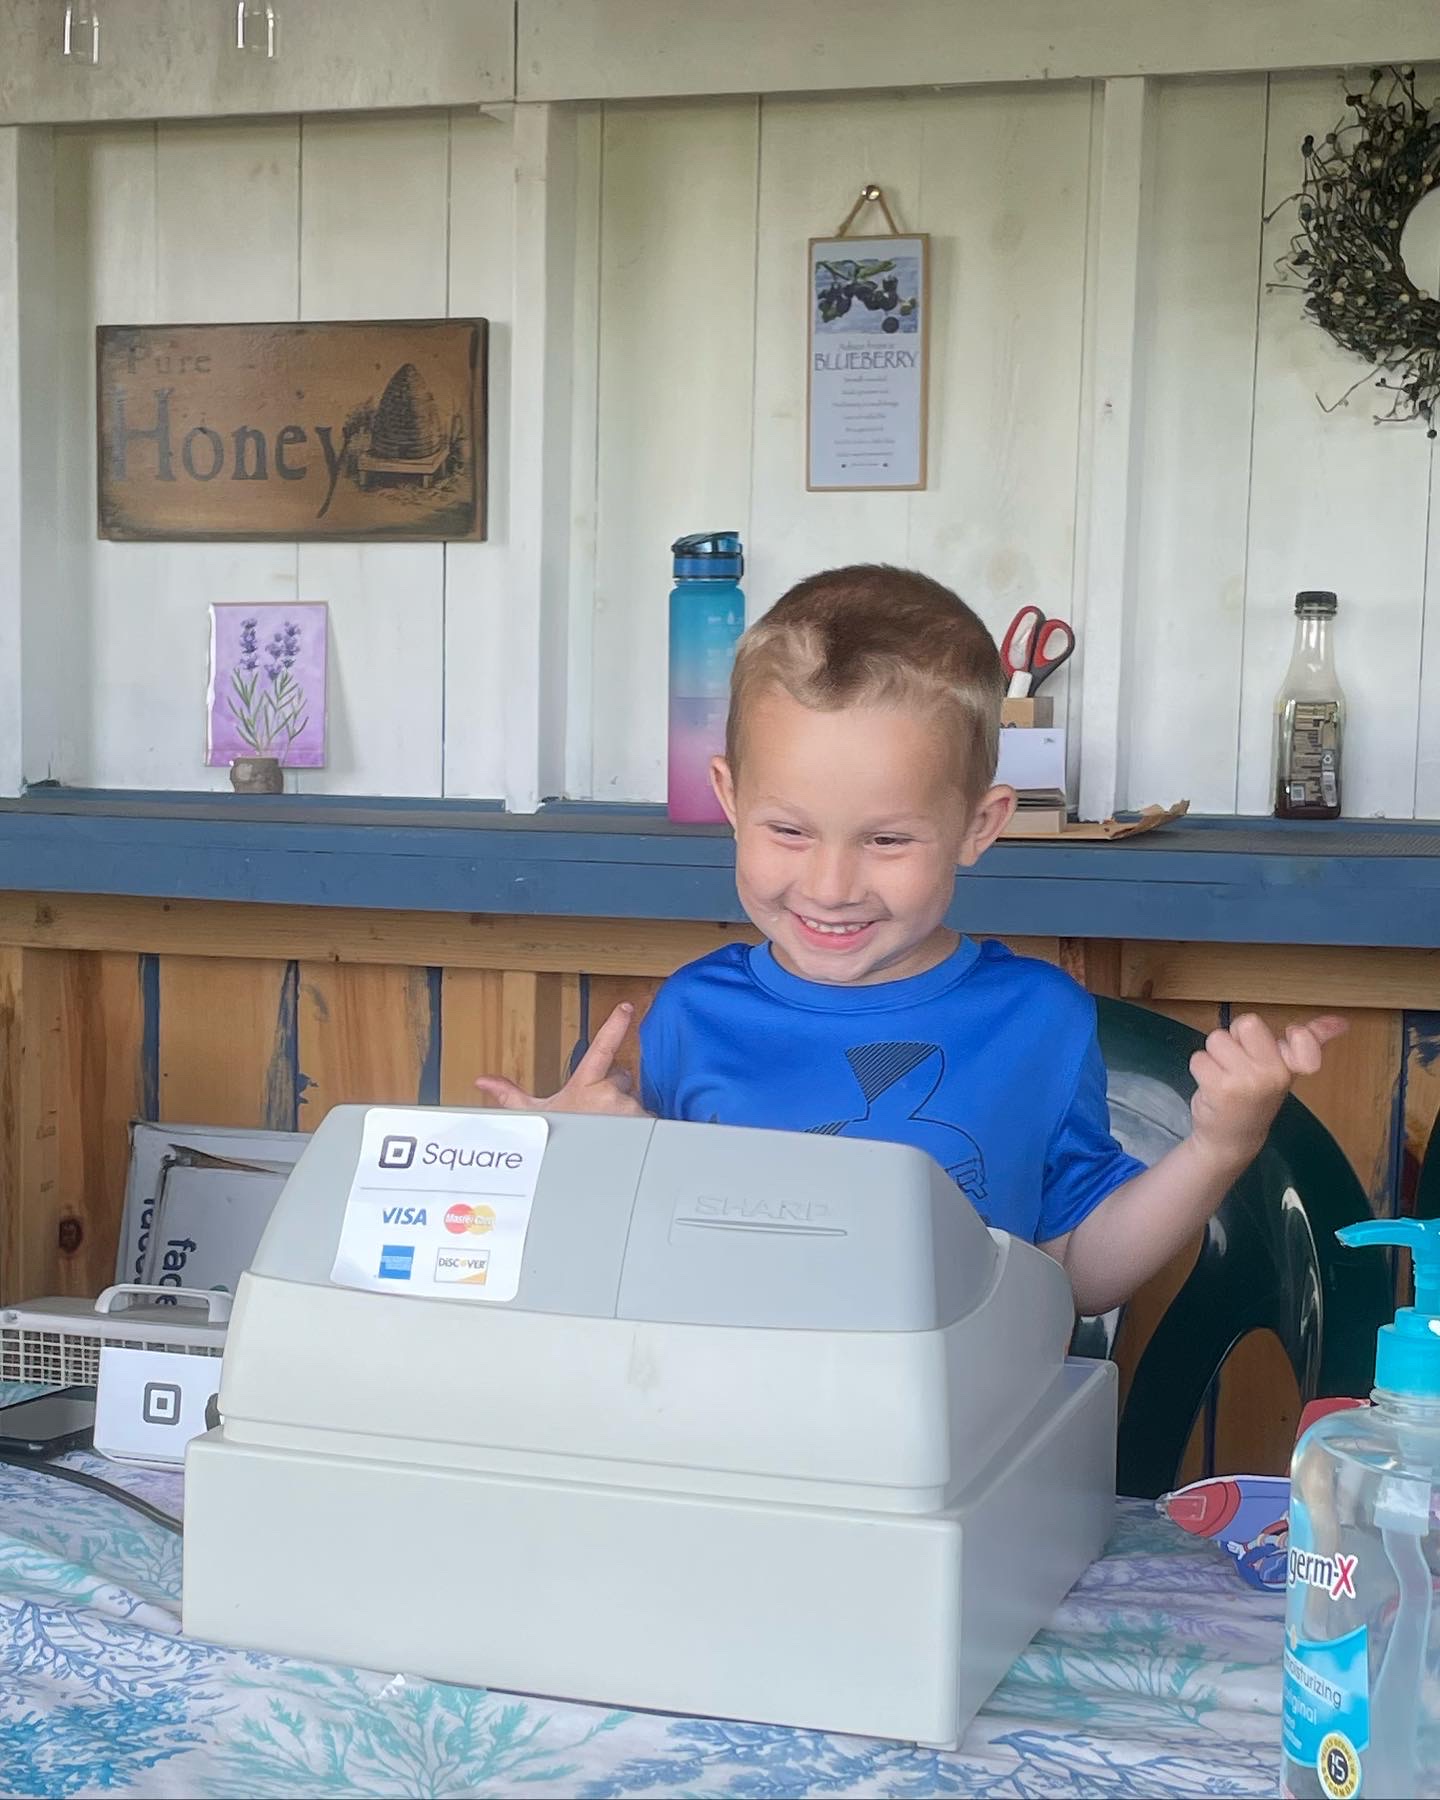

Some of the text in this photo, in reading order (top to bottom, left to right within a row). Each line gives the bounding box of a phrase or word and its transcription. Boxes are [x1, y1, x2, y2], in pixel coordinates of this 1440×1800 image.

[122, 344, 212, 375] Pure
[814, 350, 919, 371] BLUEBERRY
[111, 387, 351, 519] Honey
[422, 1142, 523, 1171] Square
[383, 1207, 428, 1226] VISA
[695, 1196, 831, 1222] SHARP
[1289, 1548, 1355, 1597] germ-X
[1331, 1752, 1346, 1782] 15
